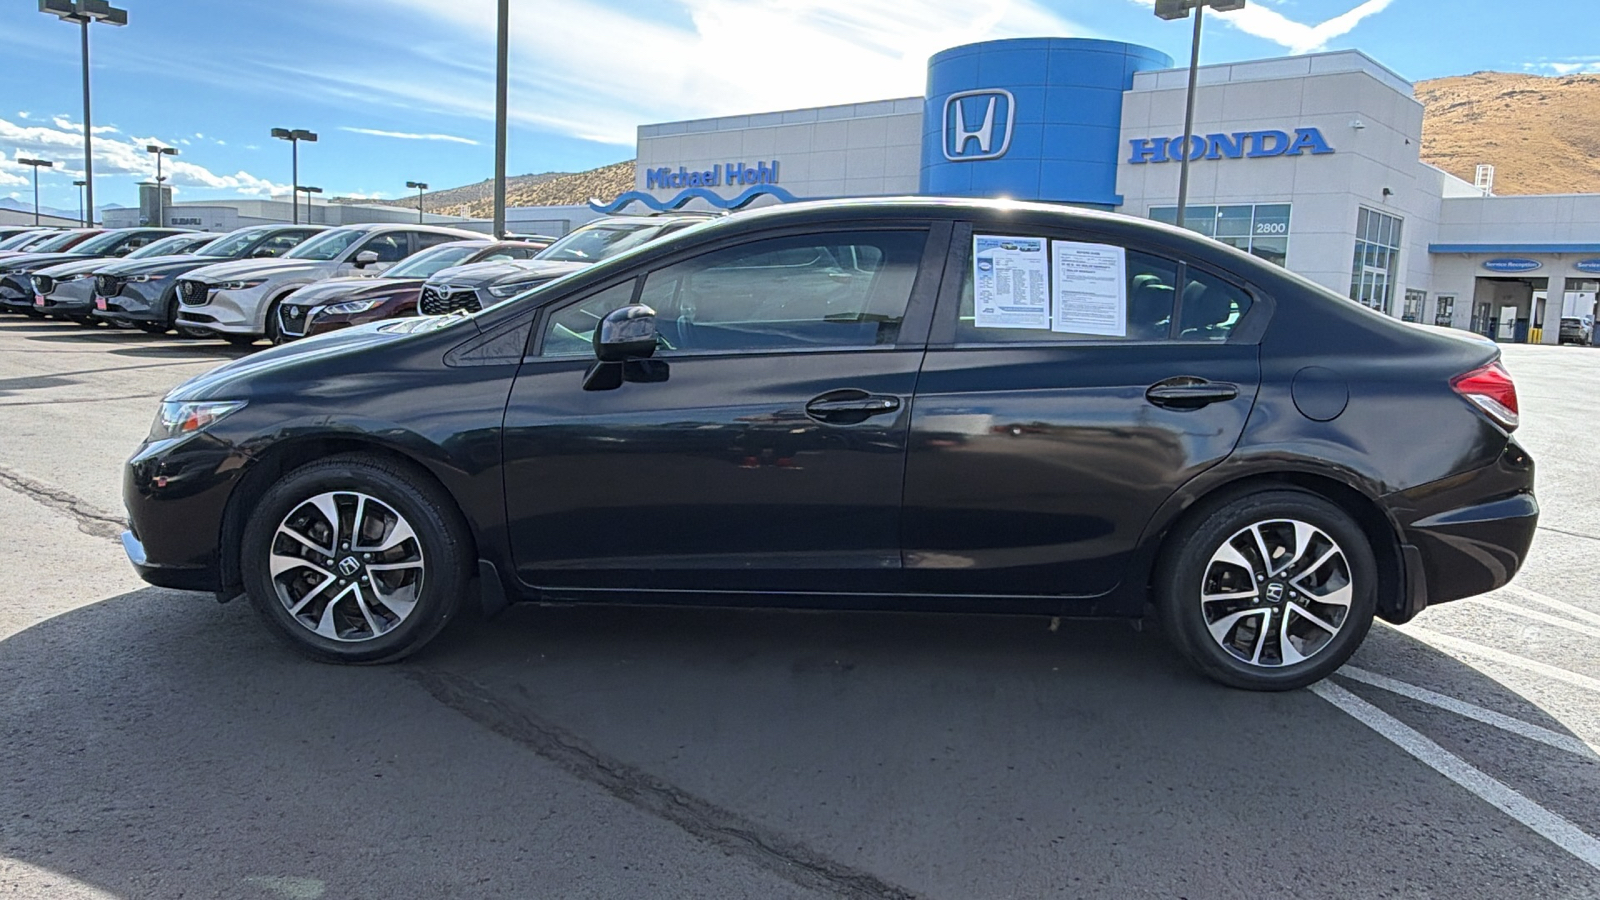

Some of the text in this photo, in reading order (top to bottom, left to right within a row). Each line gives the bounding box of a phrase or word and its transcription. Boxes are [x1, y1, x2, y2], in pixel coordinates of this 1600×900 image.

[1128, 127, 1335, 164] HONDA
[646, 159, 780, 189] Michael Hohl
[1256, 222, 1286, 234] 2800
